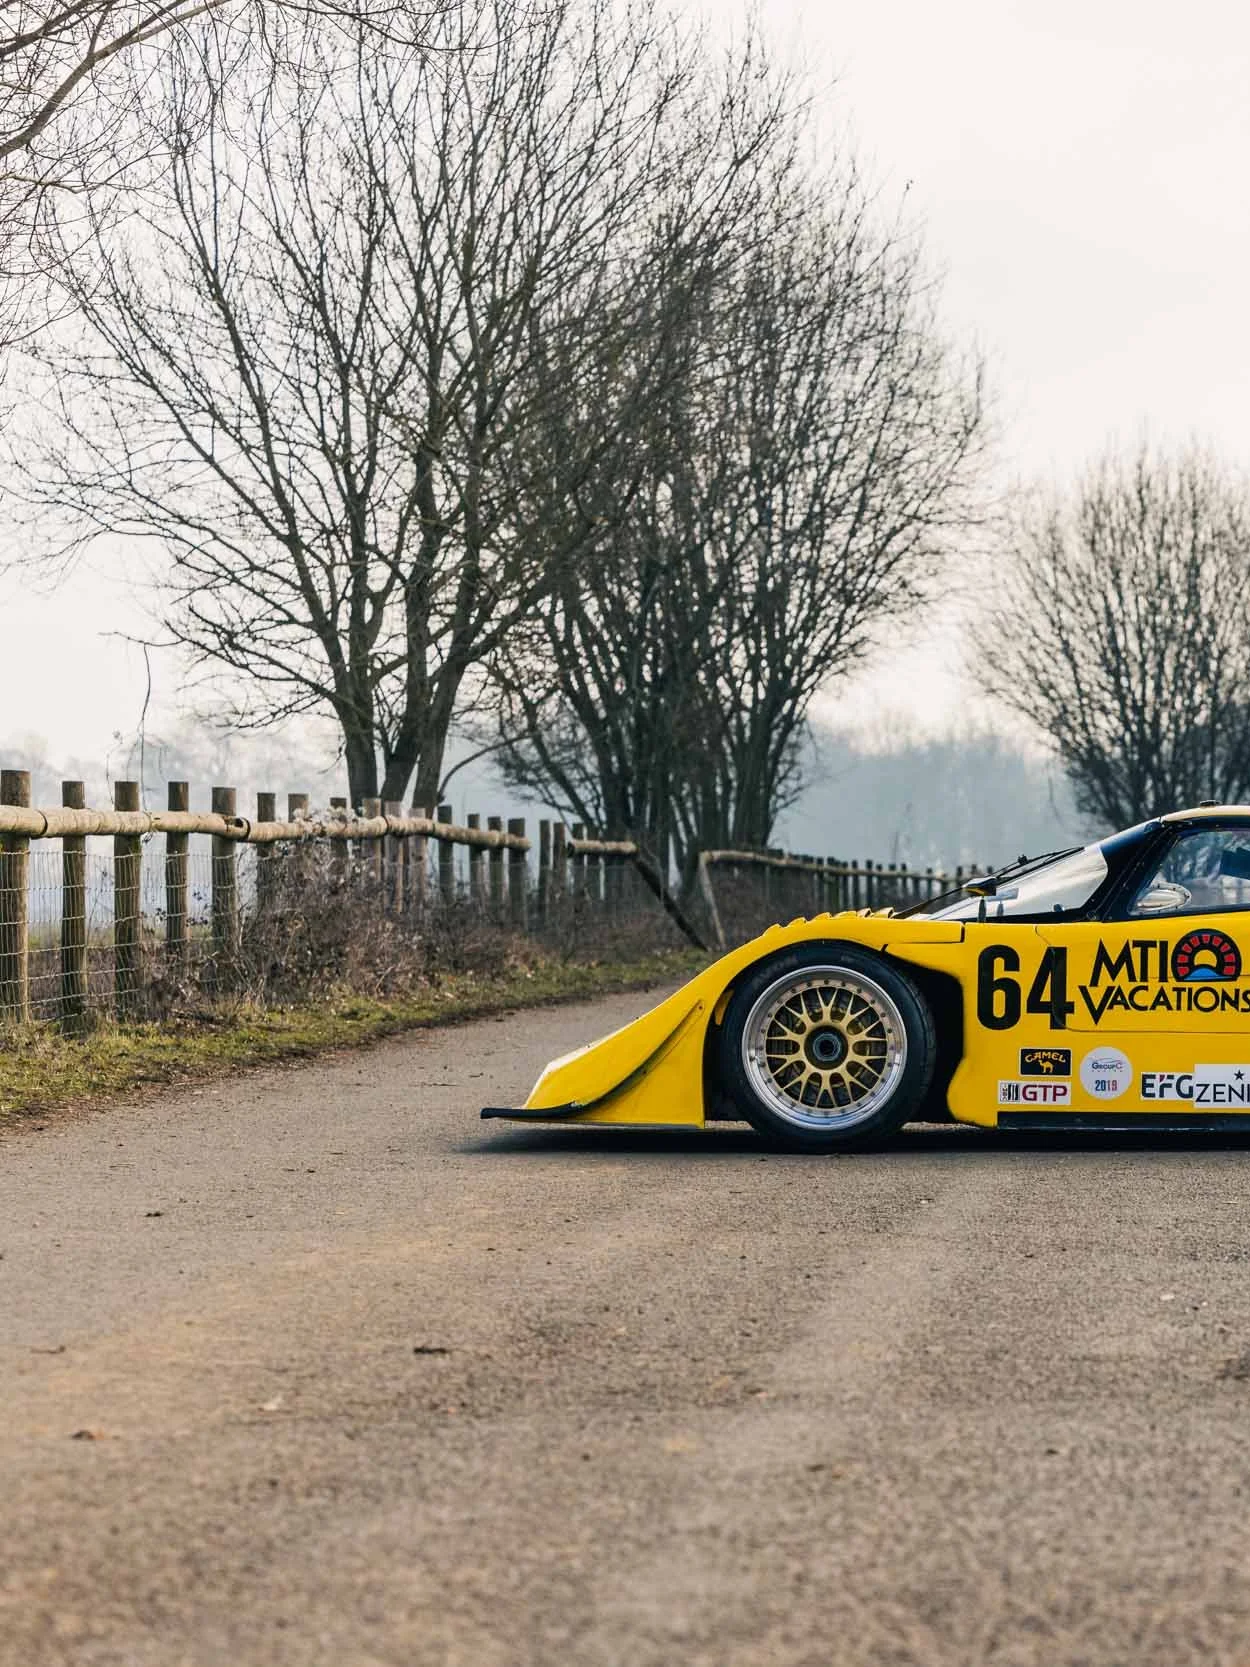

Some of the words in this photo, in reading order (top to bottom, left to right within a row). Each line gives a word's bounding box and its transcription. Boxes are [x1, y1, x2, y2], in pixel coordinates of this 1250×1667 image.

[1090, 938, 1169, 987] MTI
[977, 944, 1075, 1030] 64
[1024, 1051, 1067, 1063] CAMEL
[1022, 1084, 1068, 1102] GTP
[1095, 1079, 1118, 1092] 2019
[1141, 1074, 1194, 1099] EFG
